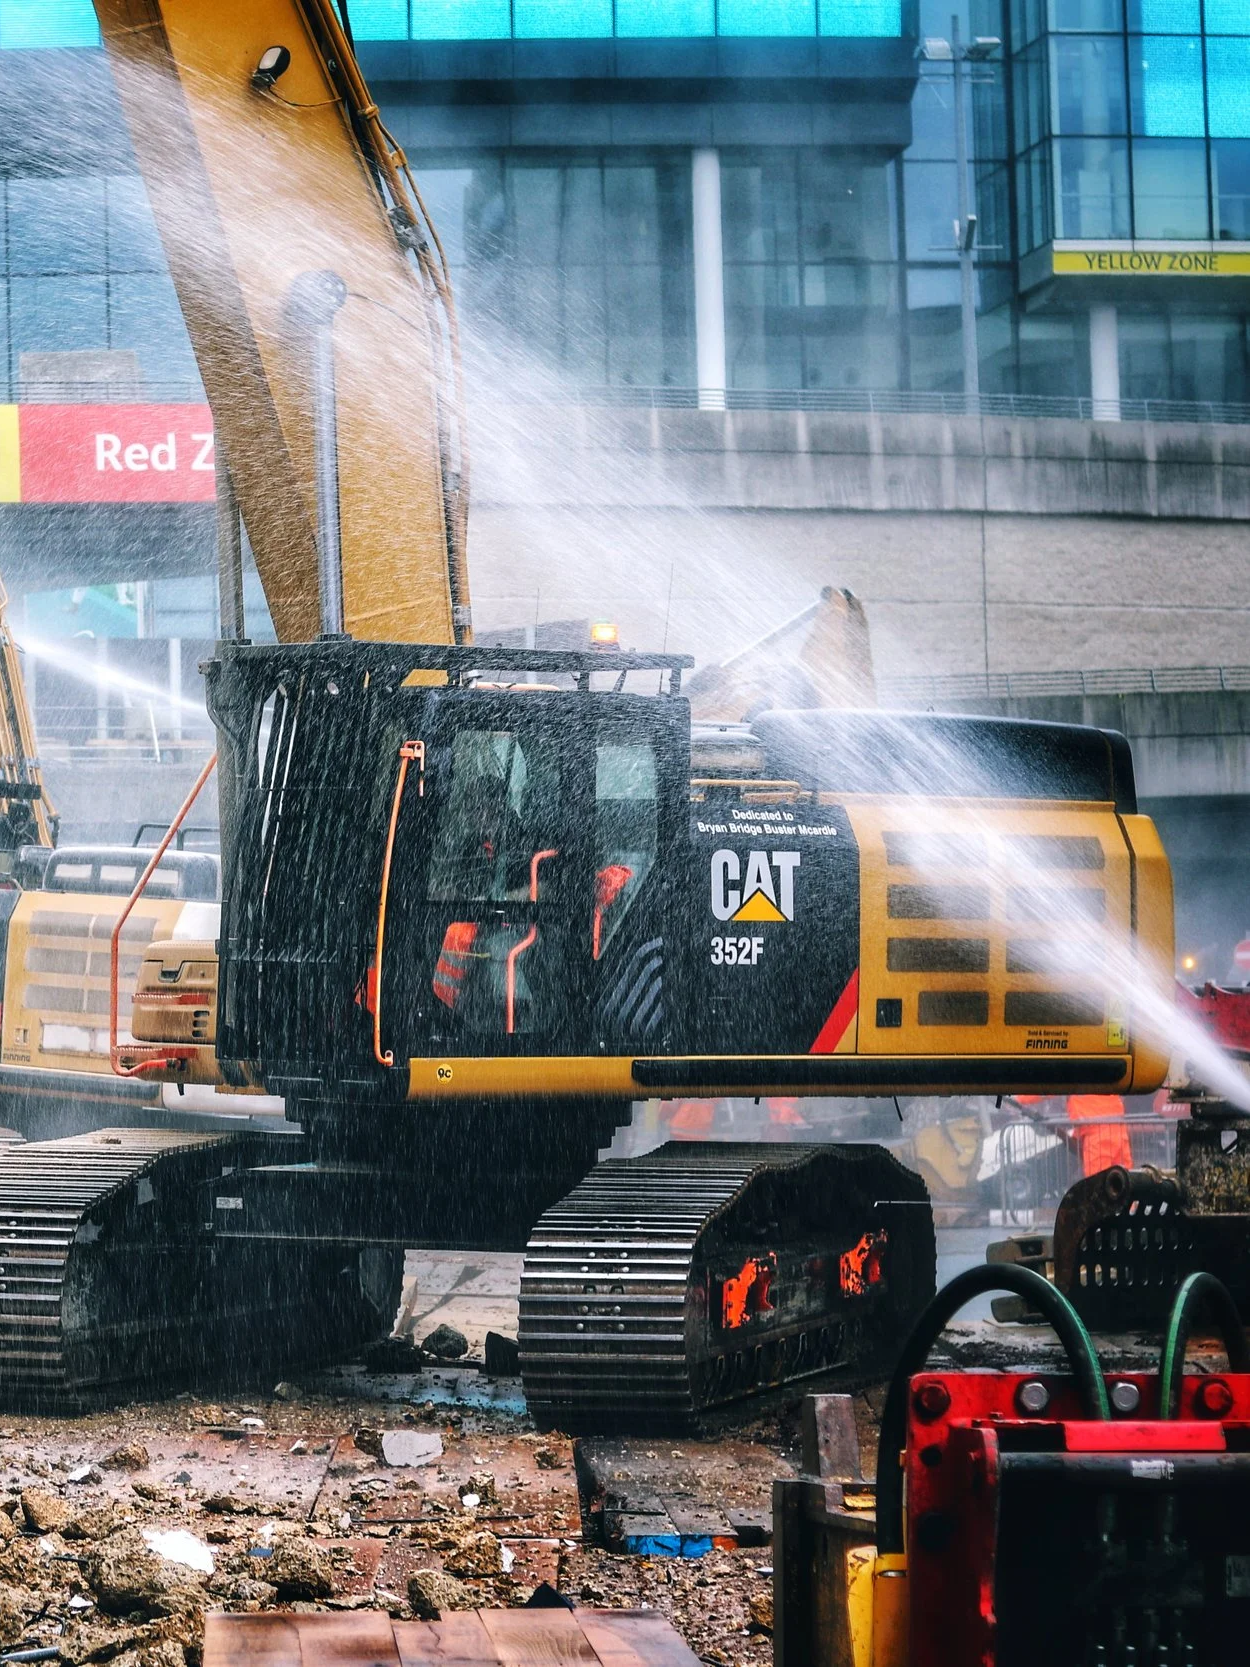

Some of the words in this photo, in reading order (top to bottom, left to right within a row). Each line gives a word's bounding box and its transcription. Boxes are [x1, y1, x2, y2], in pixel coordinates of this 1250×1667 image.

[1084, 253, 1162, 271] YELLOW
[1167, 254, 1219, 272] ZONE
[95, 432, 176, 471] Red
[731, 809, 782, 821] Dedicated
[783, 810, 794, 821] to
[697, 822, 728, 835] Bryan
[729, 823, 763, 836] Bridge
[764, 823, 797, 836] Buster
[711, 849, 800, 921] CAT
[711, 936, 764, 965] 352F
